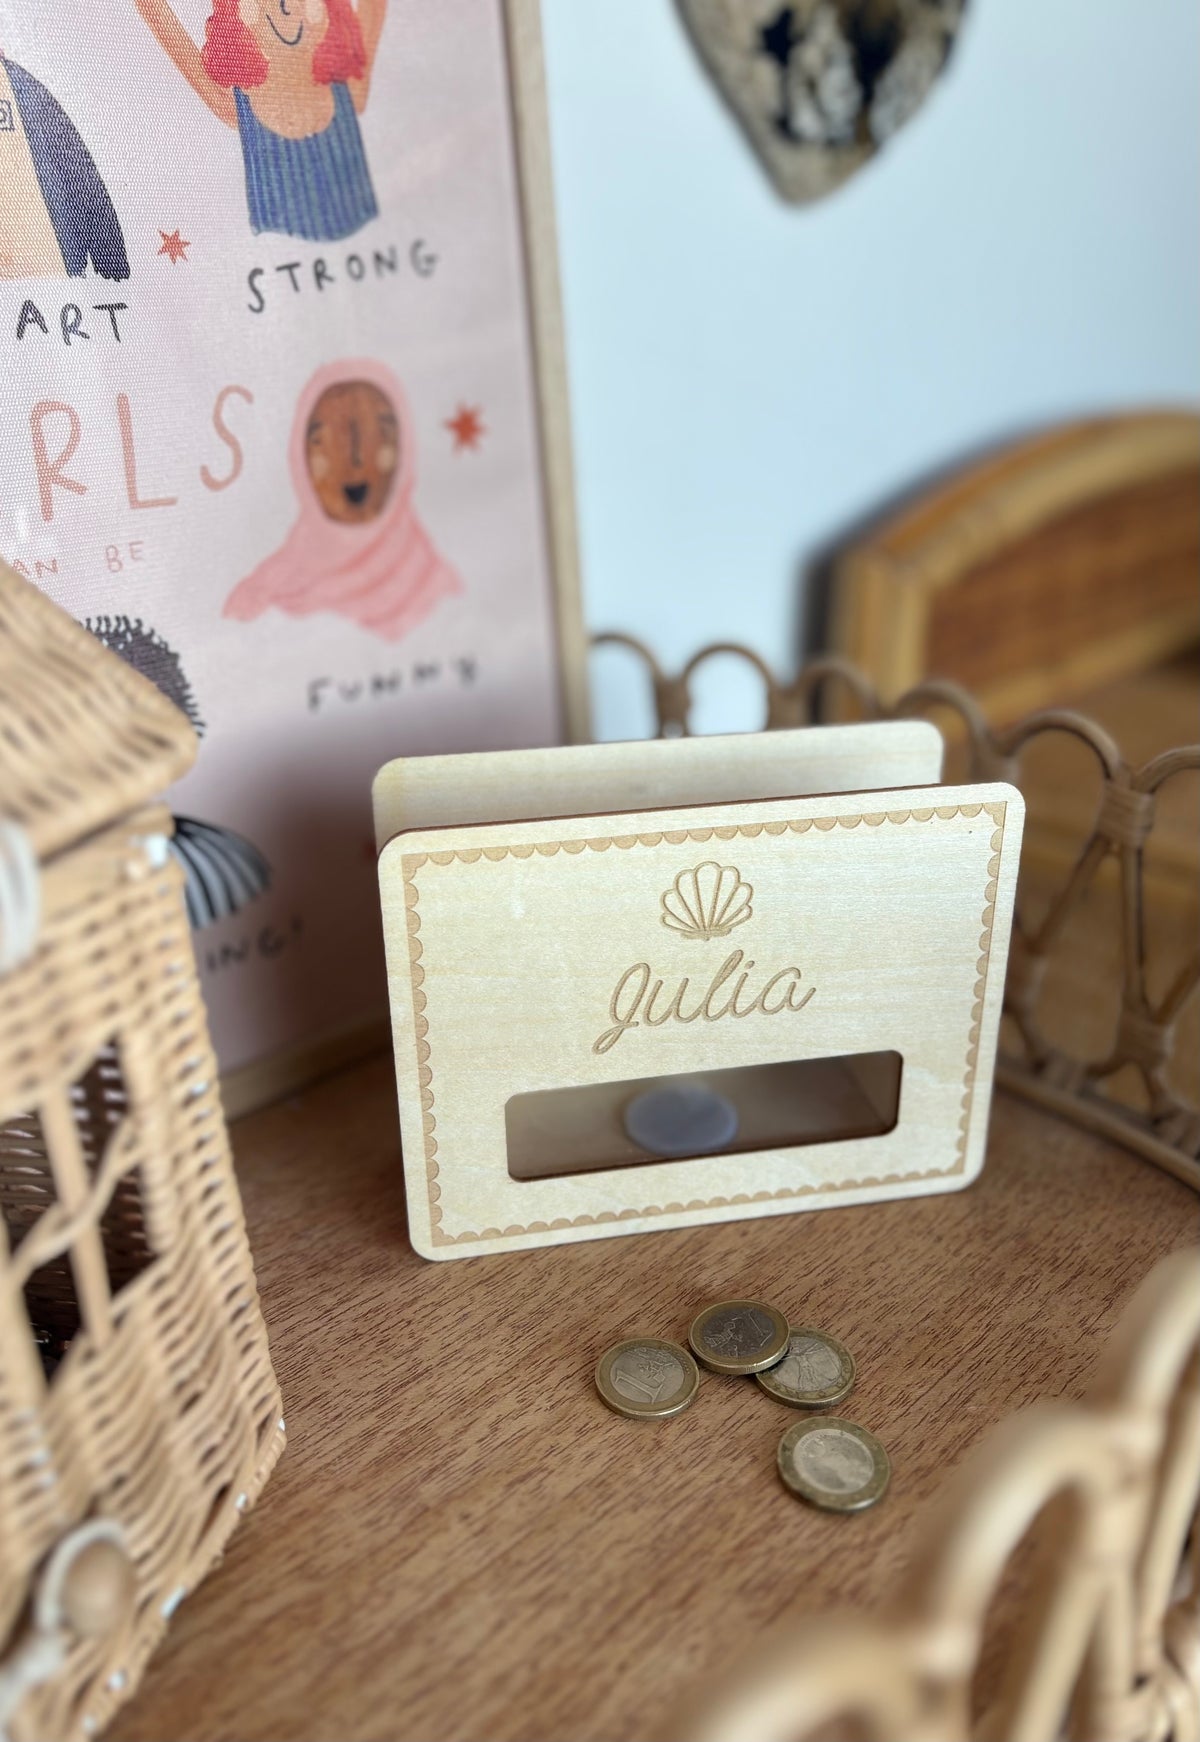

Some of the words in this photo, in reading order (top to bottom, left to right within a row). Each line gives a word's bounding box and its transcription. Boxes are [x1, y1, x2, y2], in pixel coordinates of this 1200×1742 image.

[247, 238, 438, 313] STRONG
[15, 299, 129, 345] ART
[29, 384, 254, 522] RLS
[11, 557, 59, 578] AN
[105, 540, 144, 573] BE
[591, 949, 816, 1055] Julia
